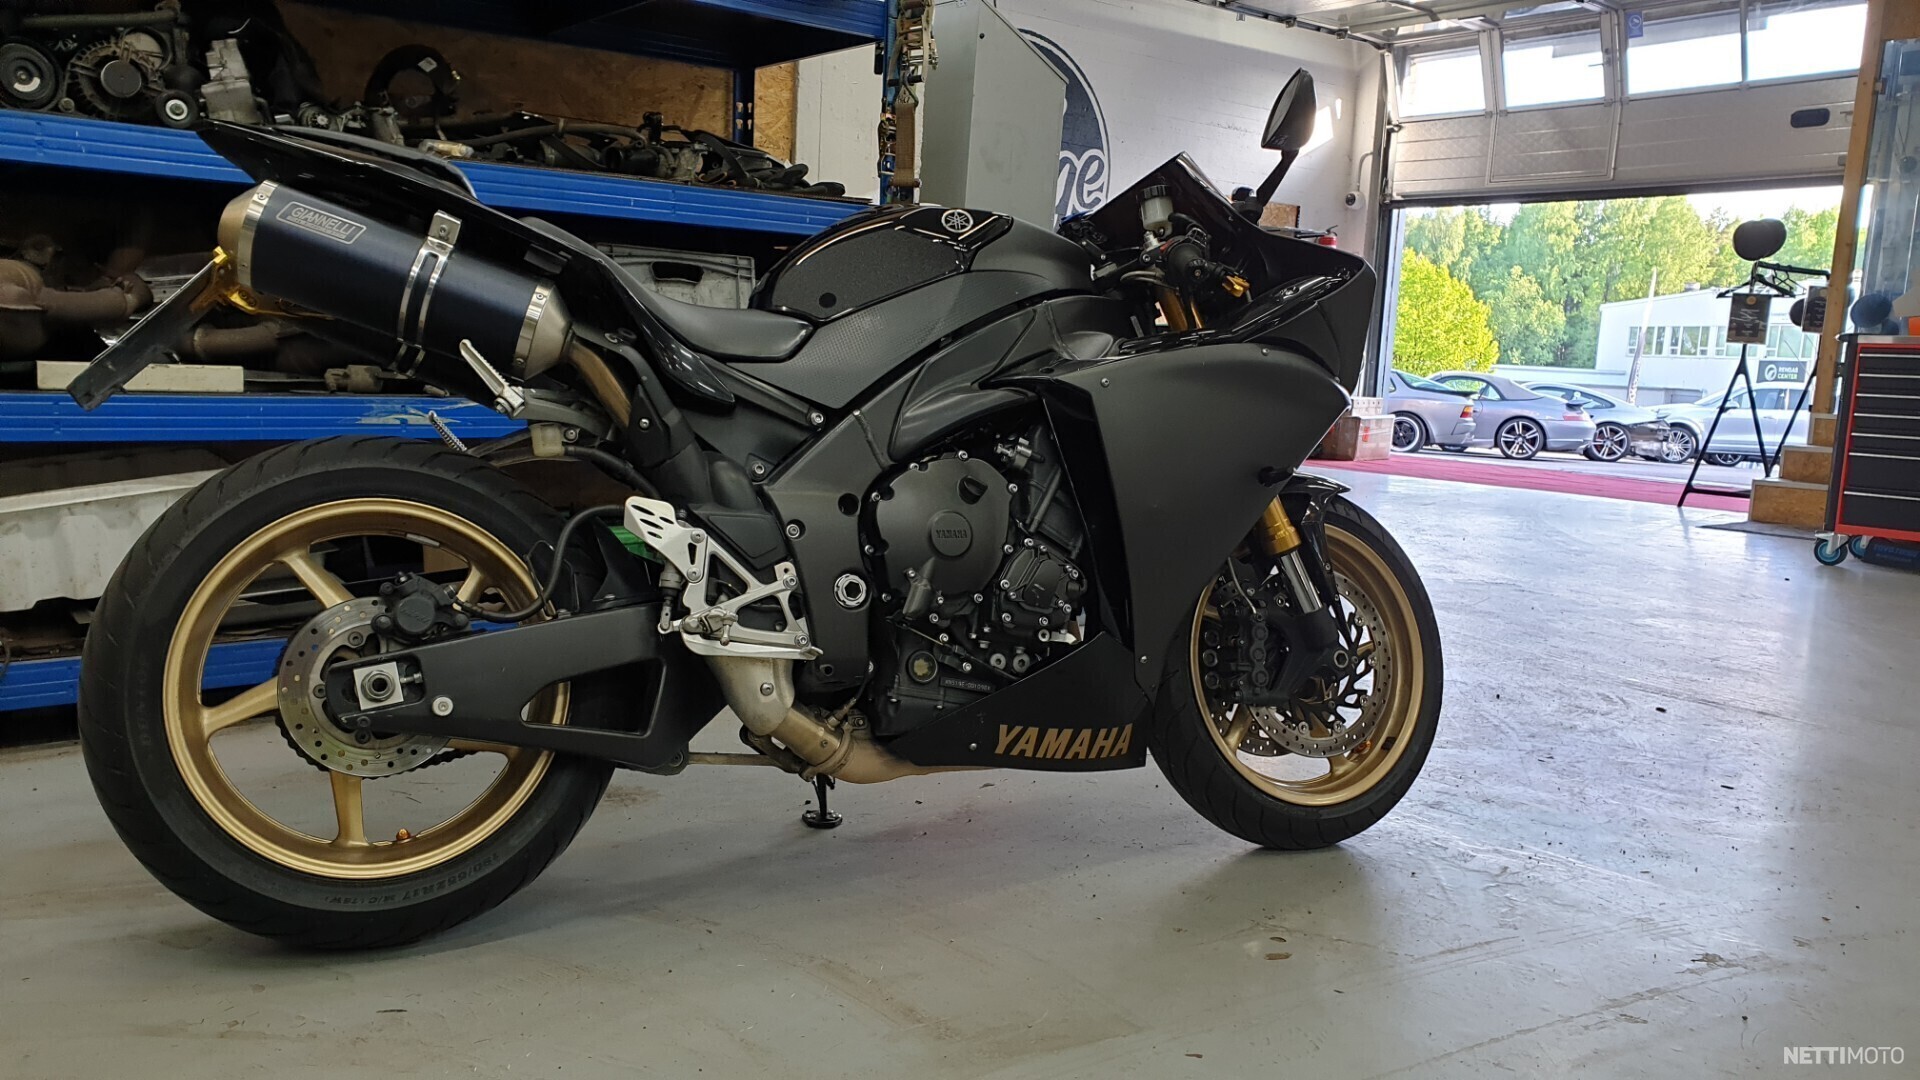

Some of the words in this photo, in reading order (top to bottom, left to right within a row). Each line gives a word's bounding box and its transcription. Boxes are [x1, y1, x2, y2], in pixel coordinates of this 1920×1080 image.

[291, 207, 356, 235] GIANNELLI
[935, 529, 968, 539] YAMAHA
[994, 722, 1134, 760] YAMAHA
